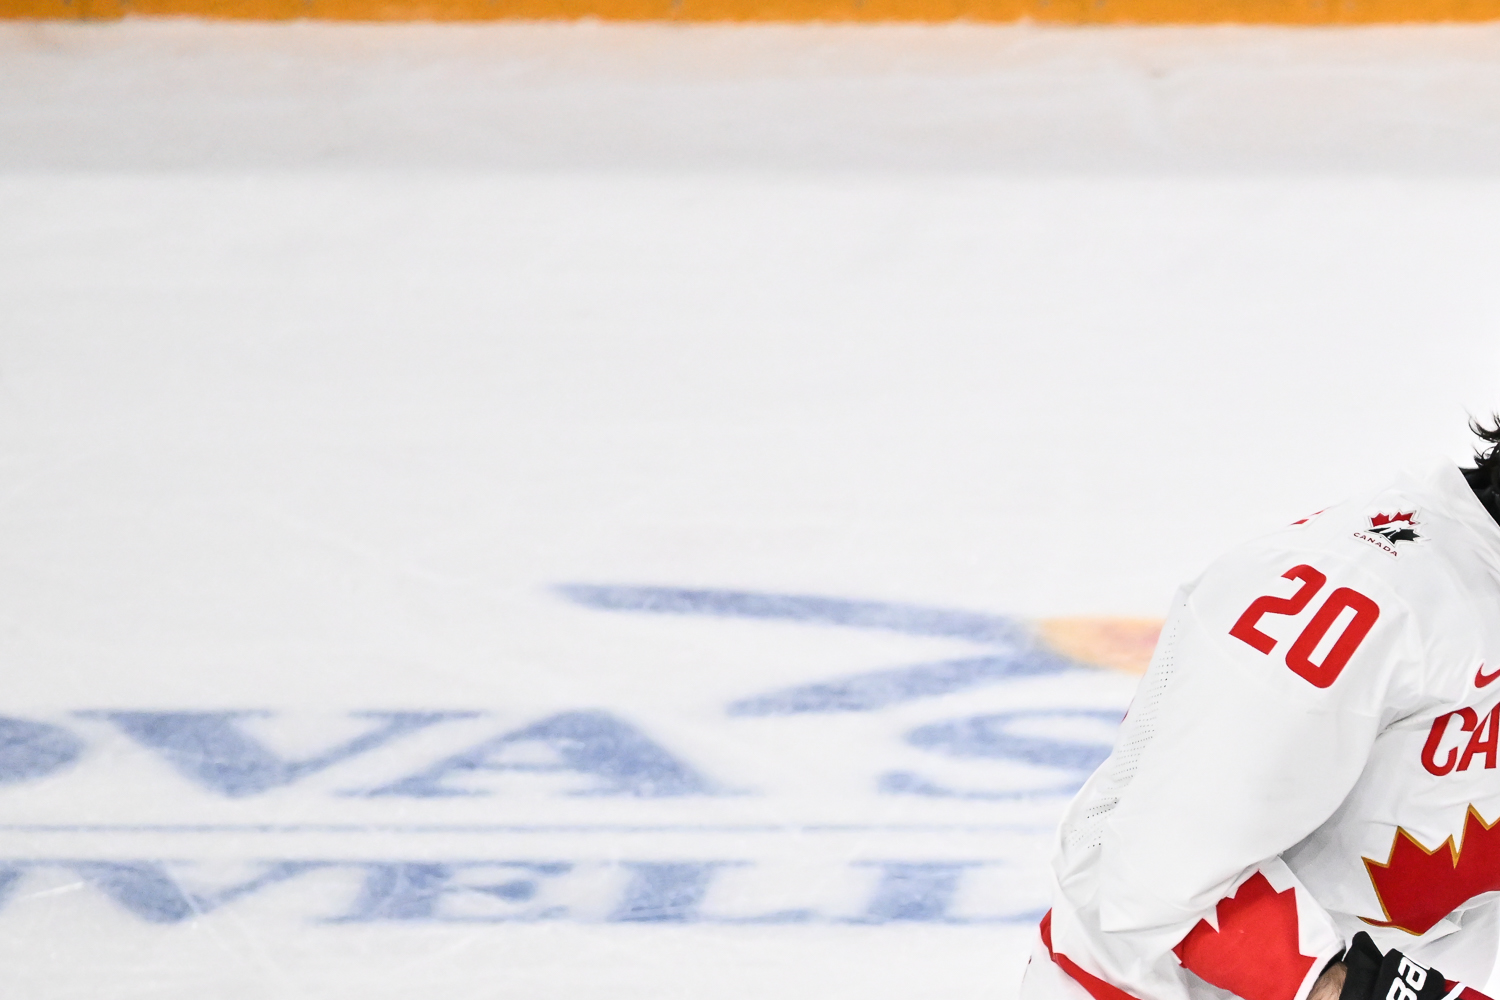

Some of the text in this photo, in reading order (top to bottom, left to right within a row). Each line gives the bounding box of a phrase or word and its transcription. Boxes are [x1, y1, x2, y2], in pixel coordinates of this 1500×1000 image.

[1353, 532, 1398, 557] CANADA
[1229, 564, 1381, 688] 20
[0, 710, 752, 798] VA
